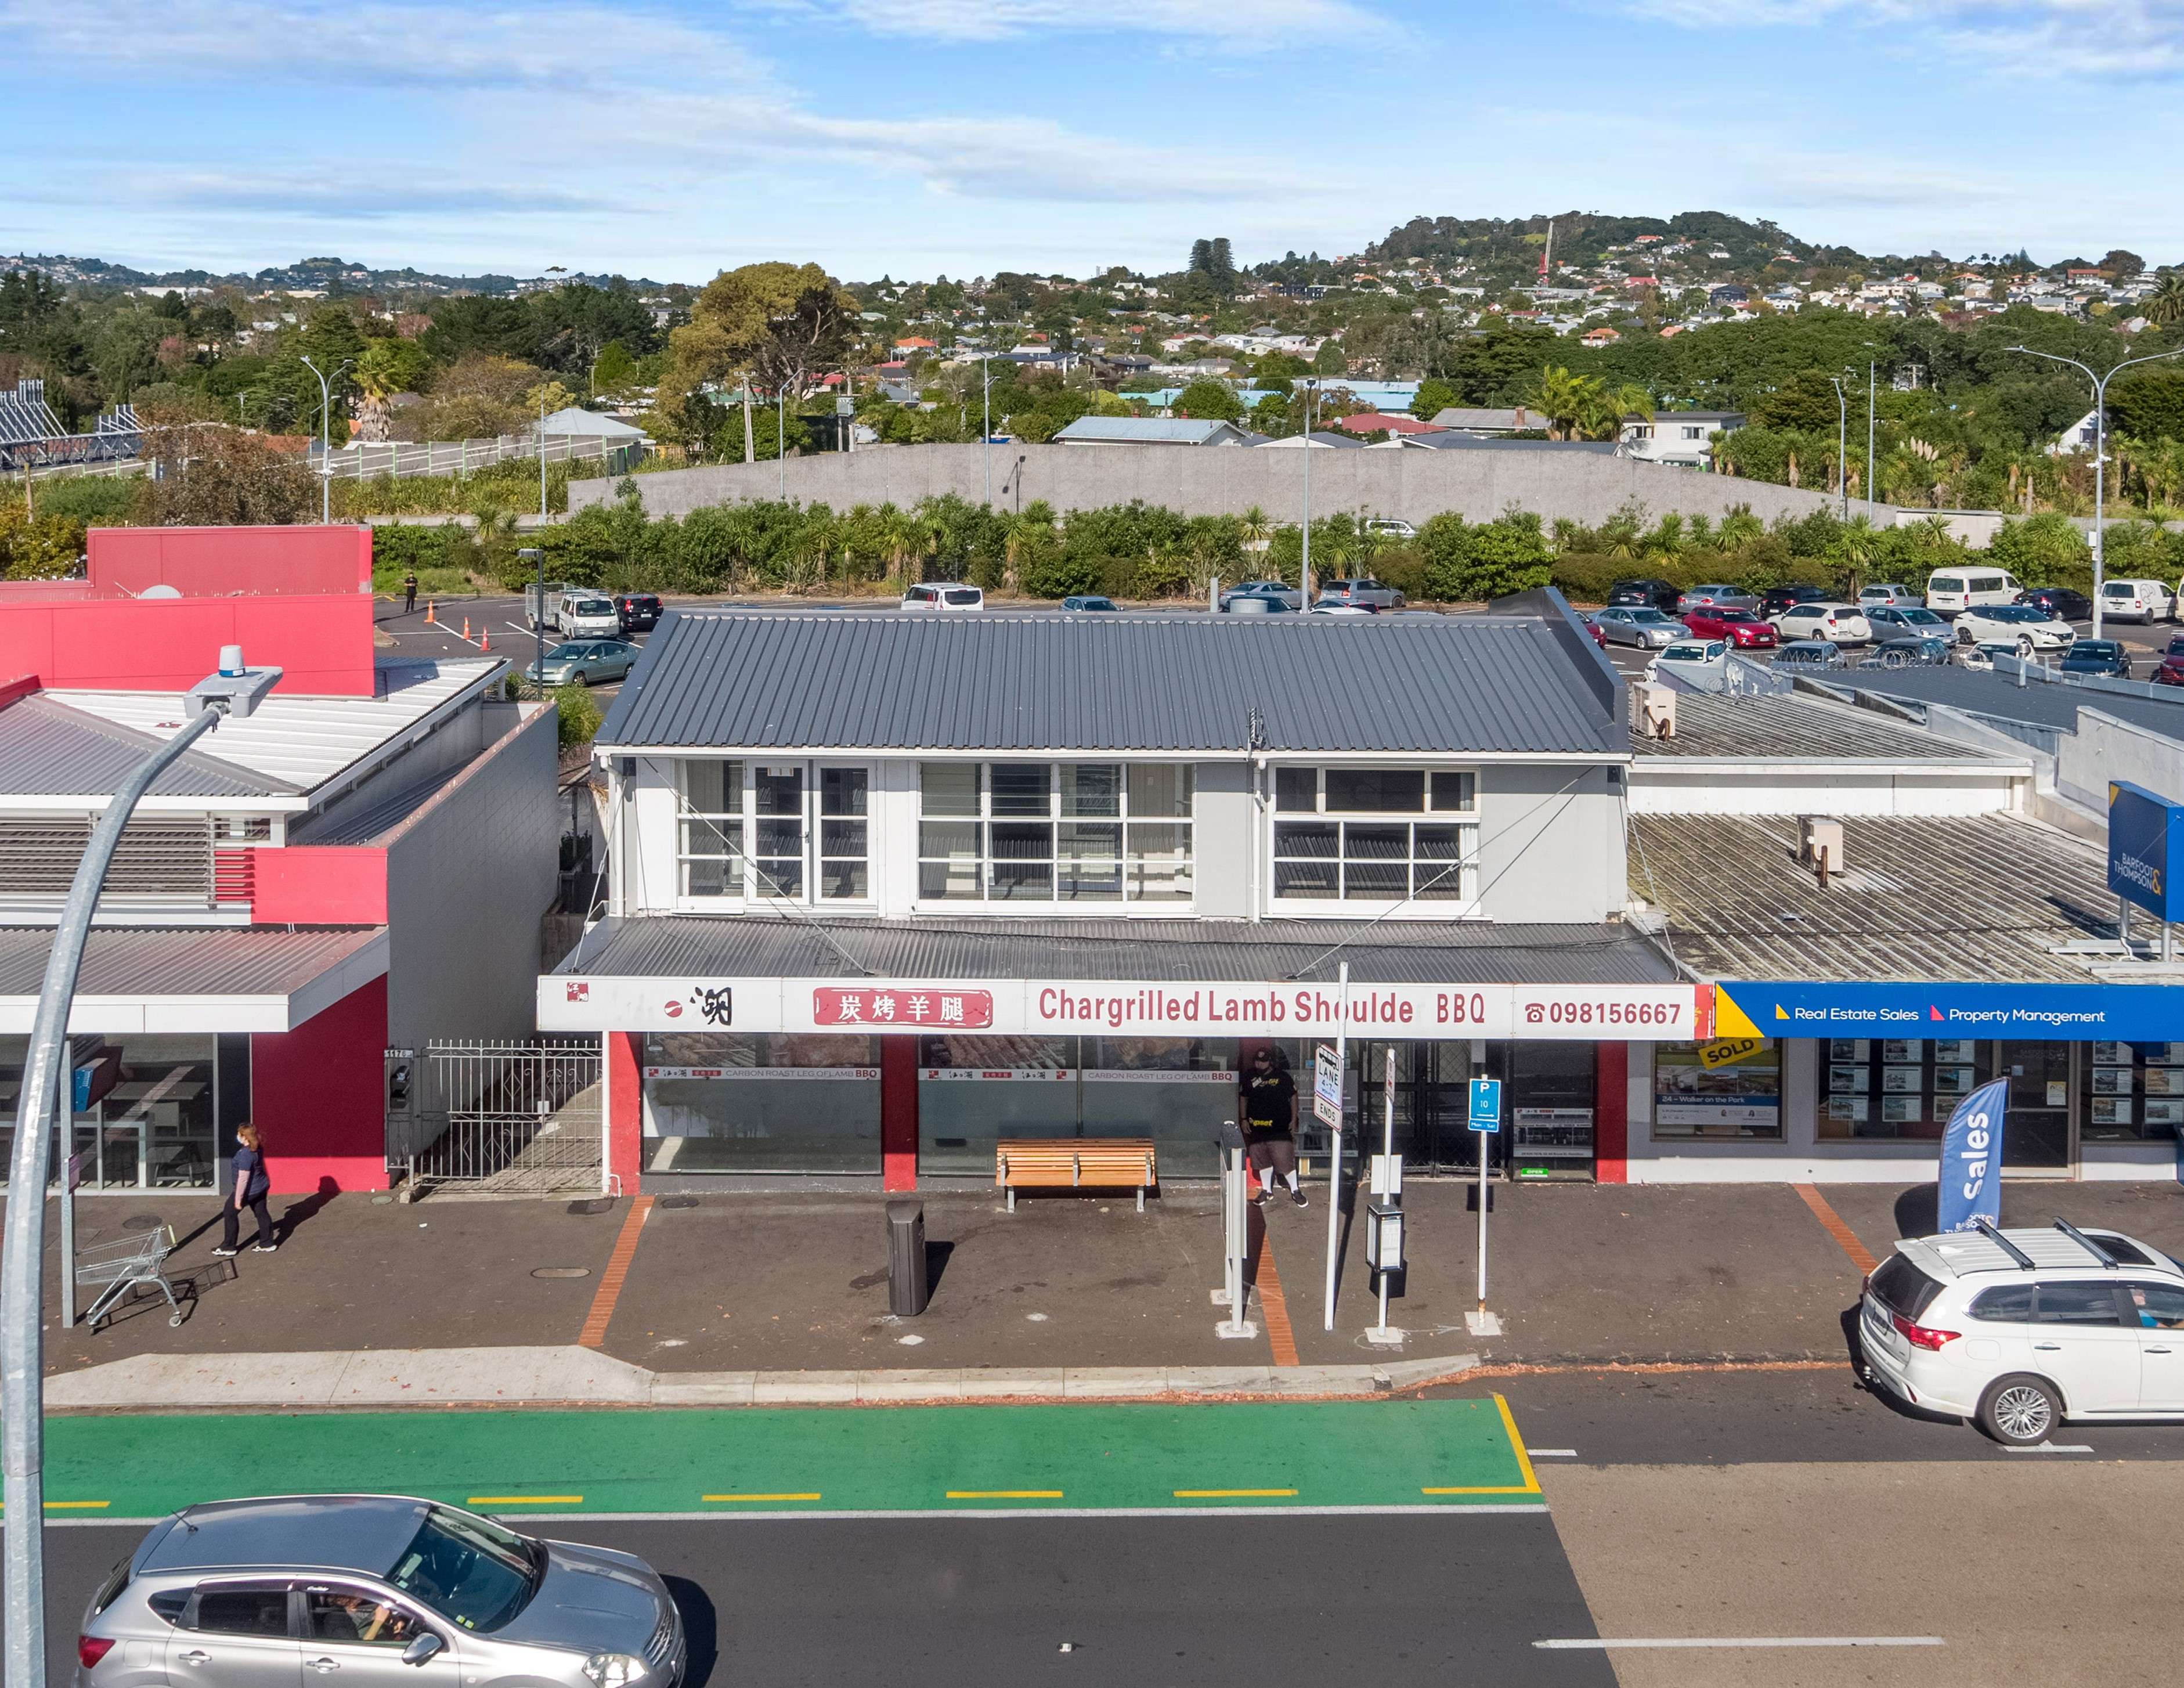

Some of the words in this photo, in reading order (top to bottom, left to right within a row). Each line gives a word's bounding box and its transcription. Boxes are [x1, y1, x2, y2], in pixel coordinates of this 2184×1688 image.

[2114, 860, 2153, 890] THOMPSON
[2122, 853, 2153, 877] BARFOOT
[838, 994, 963, 1022] 炭烤羊腿
[1039, 989, 1199, 1027] Chargrilled
[1209, 991, 1286, 1022] Lamb
[1437, 993, 1485, 1023] BBQ
[1550, 1002, 1681, 1024] 098156667
[1795, 1008, 1826, 1020] Real
[1831, 1008, 1876, 1020] Estate
[1880, 1008, 1919, 1021] Sales
[1950, 1009, 2009, 1024] Property
[2013, 1009, 2105, 1026] Management
[1706, 1039, 1755, 1063] SOLD
[1212, 1073, 1232, 1081] BBQ
[1319, 1063, 1338, 1087] LANE
[1480, 1083, 1490, 1093] P
[1320, 1103, 1335, 1121] ENDS
[1480, 1100, 1489, 1108] 10
